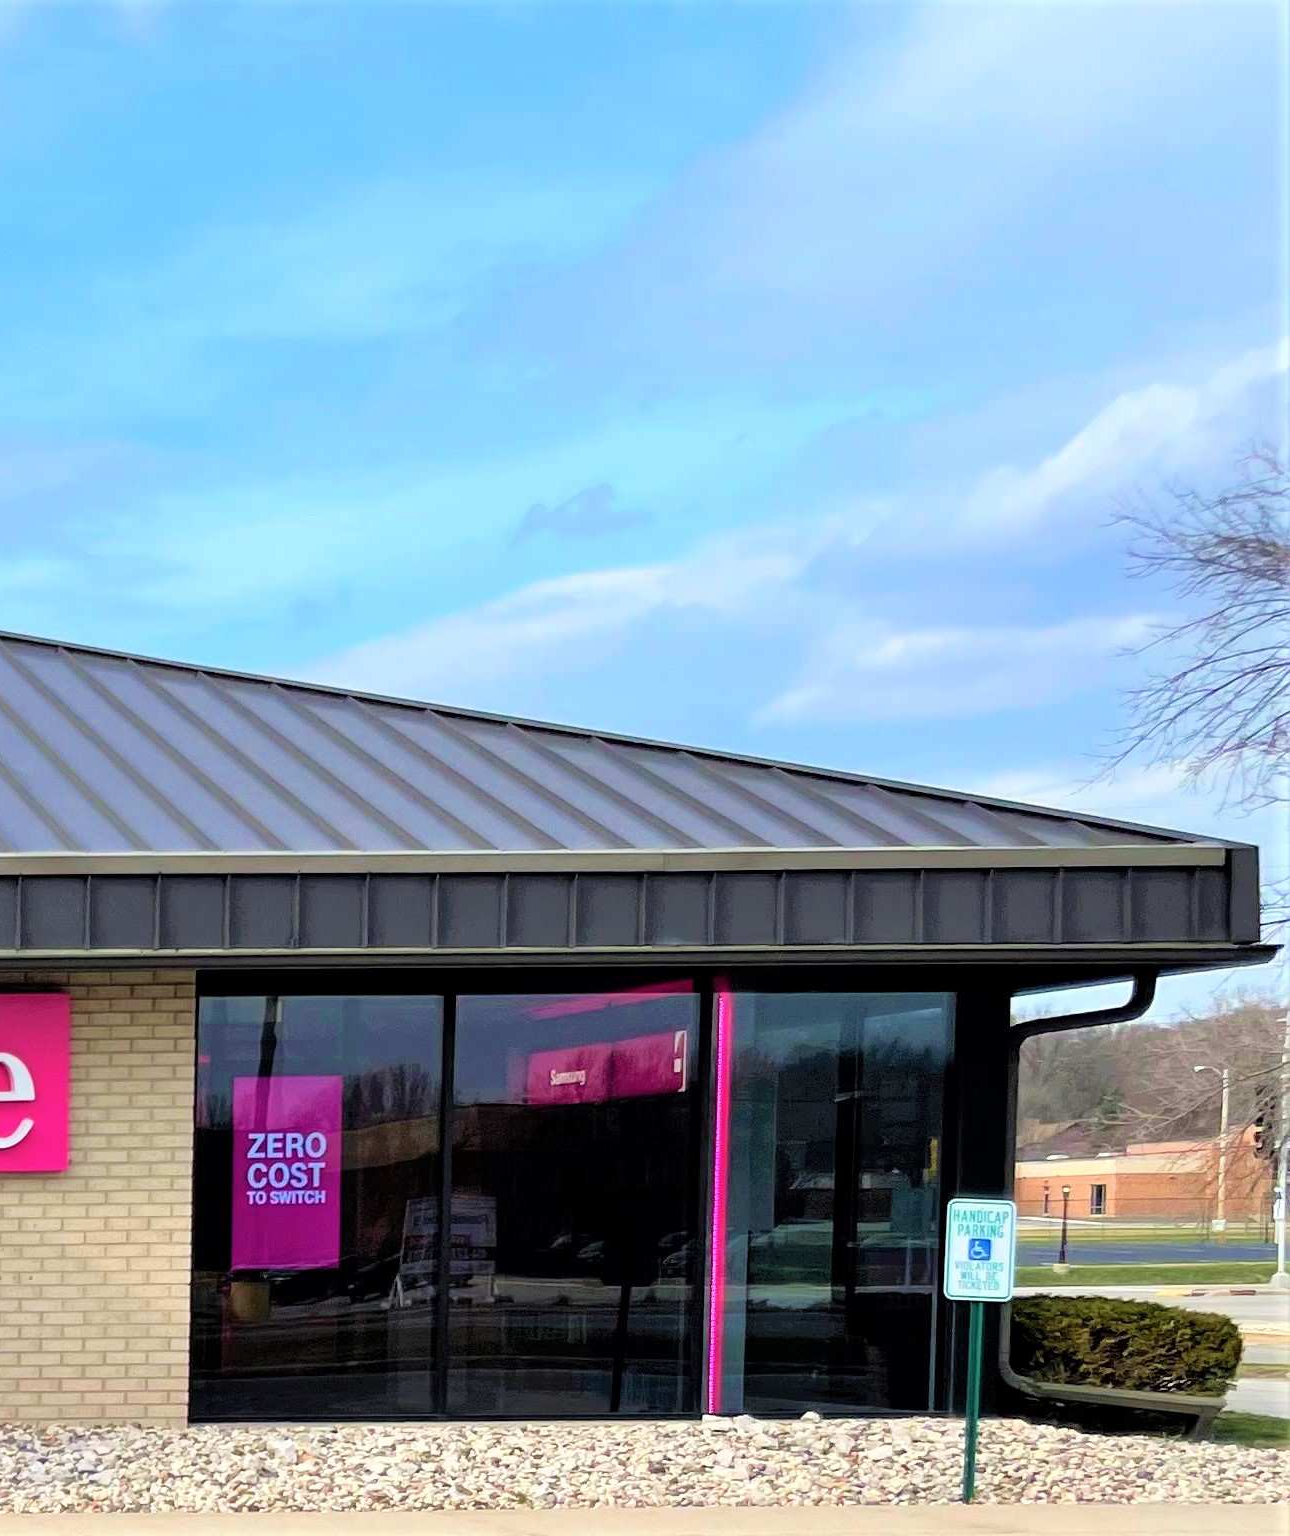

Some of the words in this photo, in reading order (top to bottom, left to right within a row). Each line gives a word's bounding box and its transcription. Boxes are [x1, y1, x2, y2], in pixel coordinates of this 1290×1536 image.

[247, 1132, 327, 1158] ZERO
[247, 1162, 326, 1188] COST
[246, 1191, 267, 1205] TO
[269, 1190, 326, 1204] SWITCH
[953, 1209, 1009, 1224] HANDICAP
[957, 1224, 1004, 1238] PARKING
[955, 1262, 1004, 1272] VIOLATORS
[960, 1272, 981, 1281] WILL
